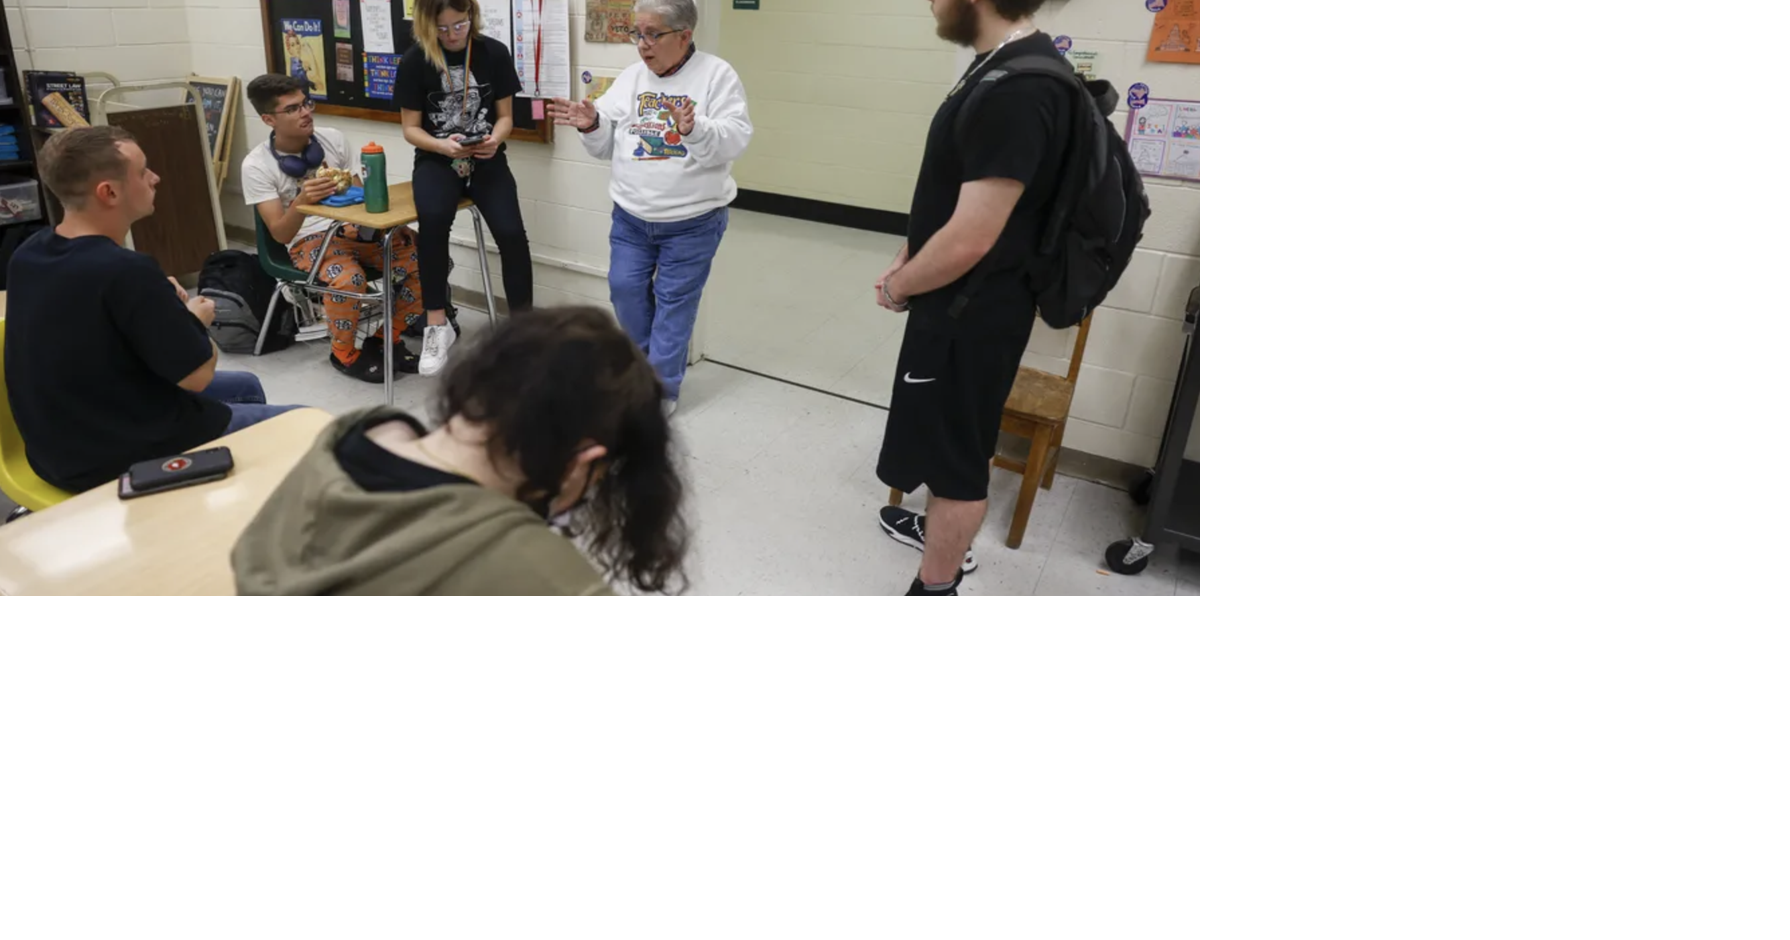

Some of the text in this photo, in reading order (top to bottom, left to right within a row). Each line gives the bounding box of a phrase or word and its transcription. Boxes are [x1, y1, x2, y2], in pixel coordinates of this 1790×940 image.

[283, 20, 321, 32] We Can Do It!
[368, 55, 402, 65] THINK LEF
[370, 69, 389, 77] THINK
[202, 87, 214, 96] YOU
